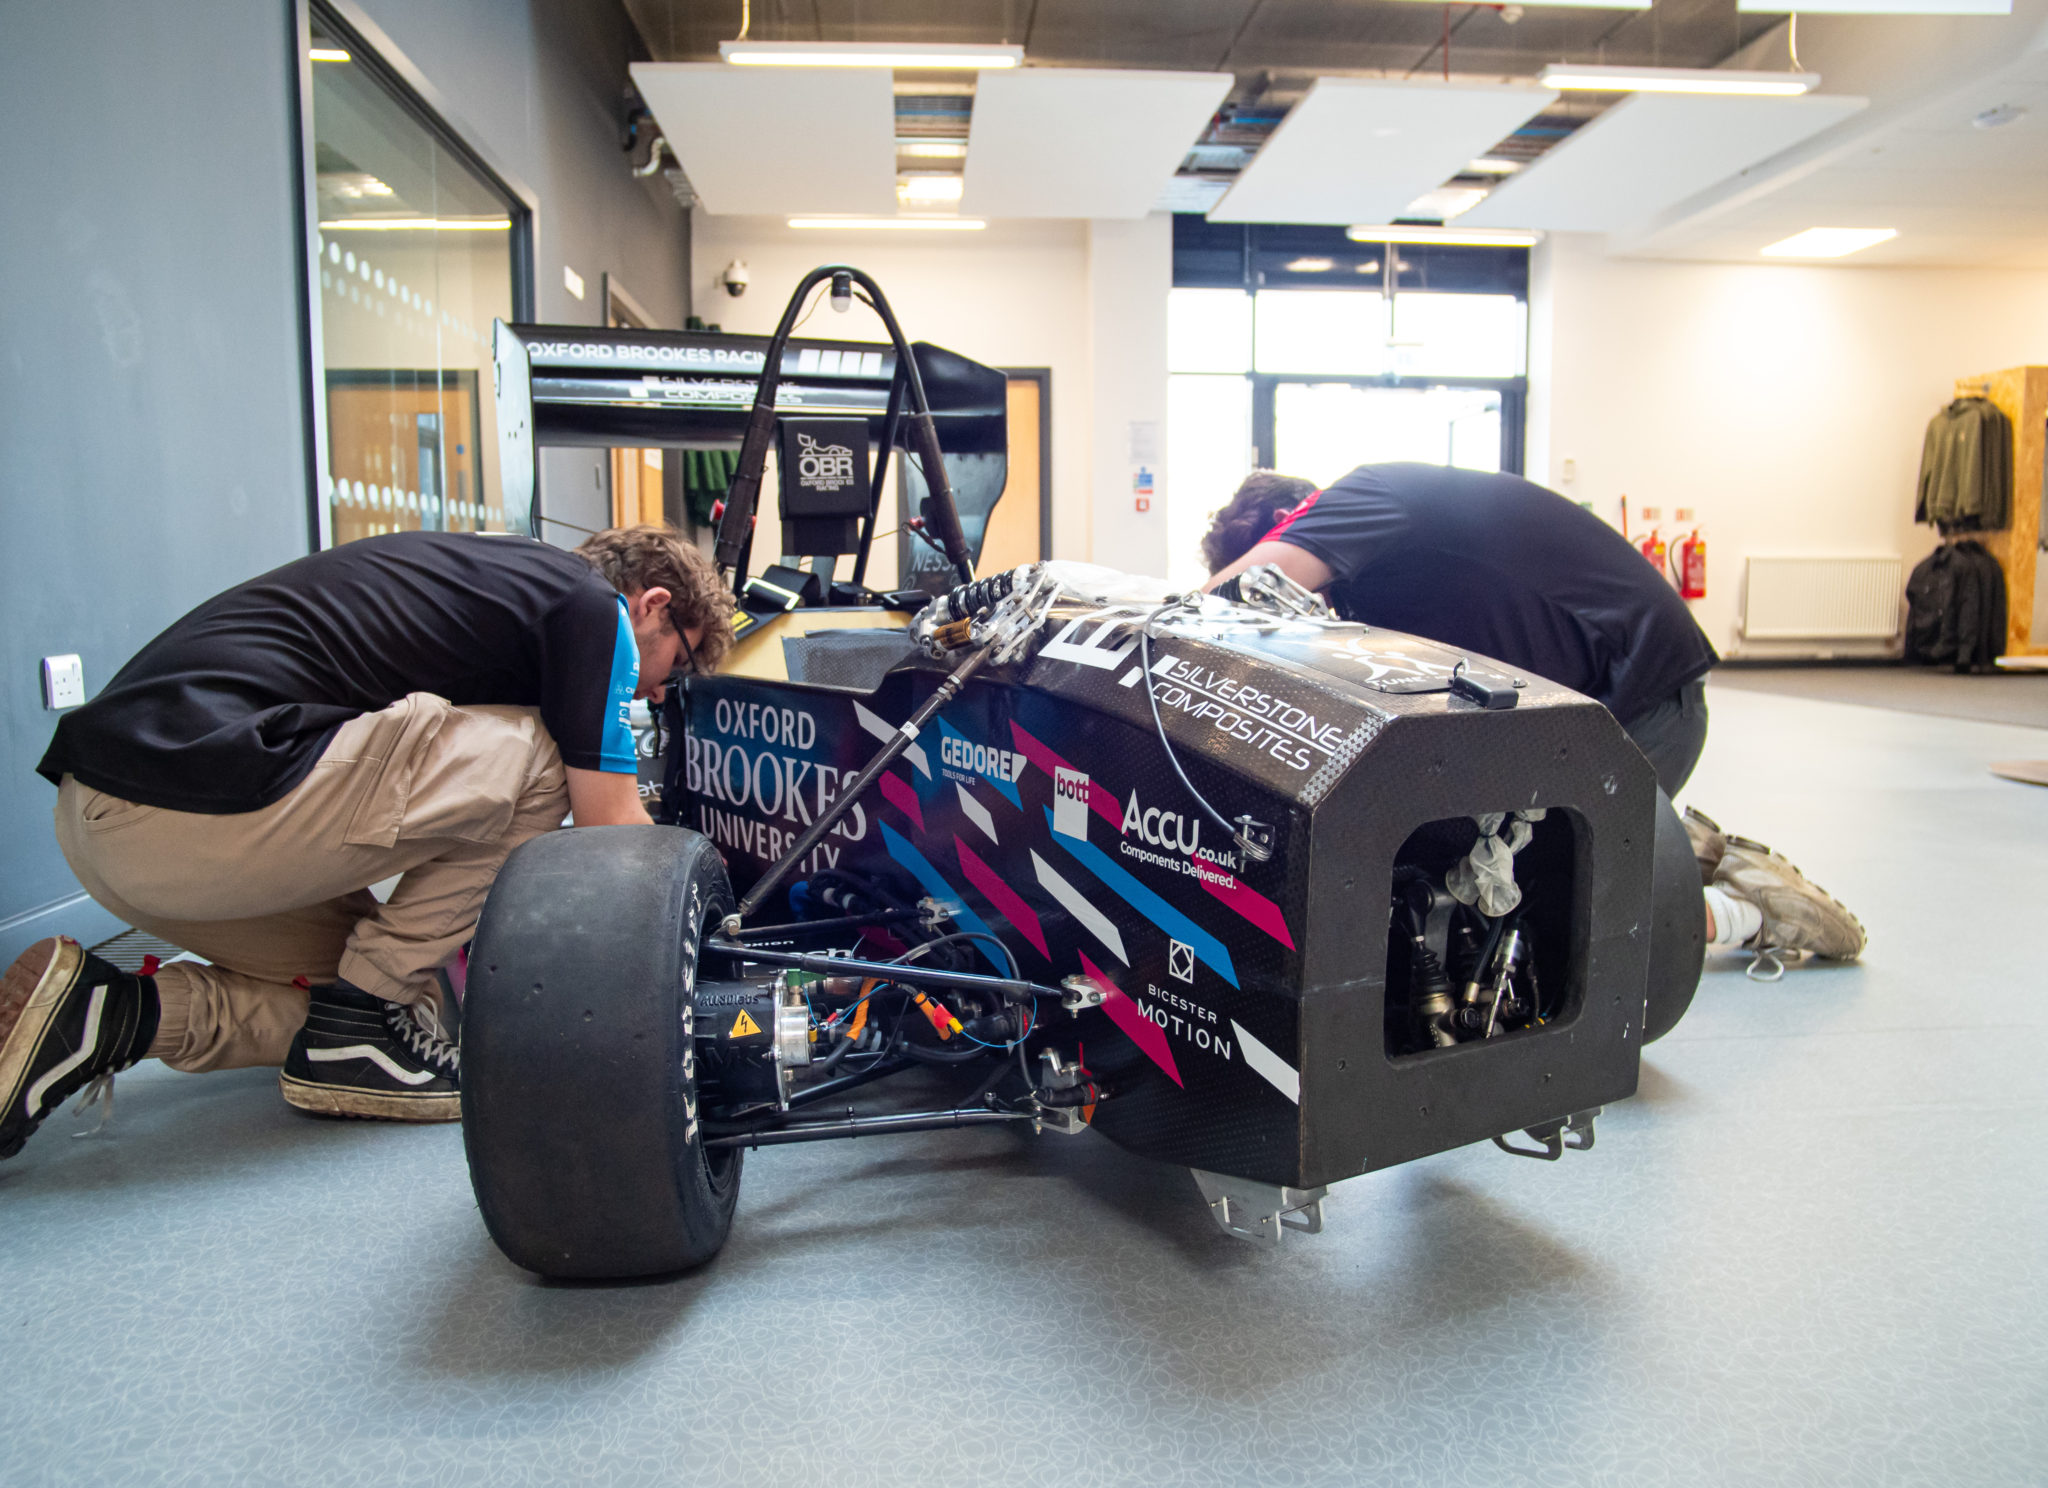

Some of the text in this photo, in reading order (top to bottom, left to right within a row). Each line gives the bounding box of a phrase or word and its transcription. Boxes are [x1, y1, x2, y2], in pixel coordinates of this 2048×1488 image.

[526, 342, 785, 365] OXFORD BROOKES RACIN
[799, 456, 854, 477] OBR
[715, 698, 816, 750] OXFORD
[1152, 682, 1311, 771] COMPOSITES
[1170, 660, 1344, 750] SILVERSTONE
[941, 736, 1011, 783] GEDORE
[942, 768, 976, 786] TOOLS FOR LIFE
[1057, 773, 1090, 804] bott
[1120, 841, 1237, 890] Components Delivered.
[1148, 983, 1217, 1024] BICESTER
[1138, 998, 1230, 1060] MOTION
